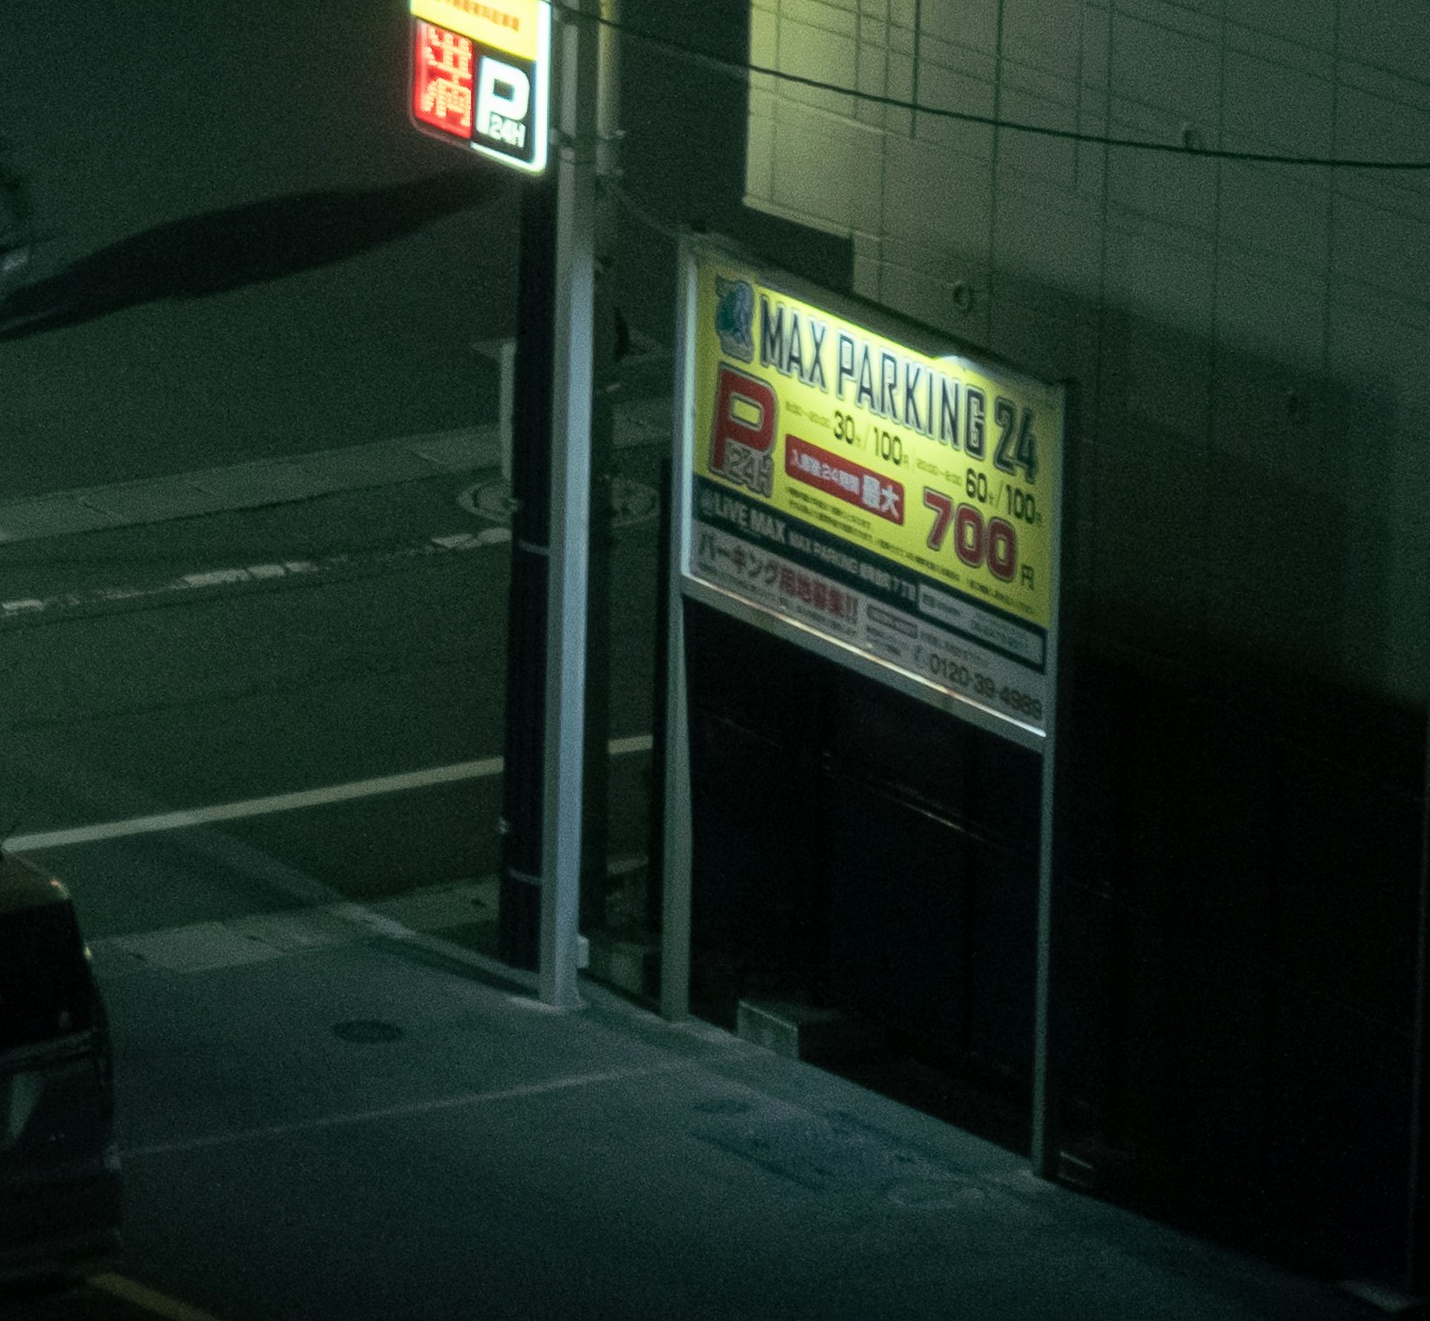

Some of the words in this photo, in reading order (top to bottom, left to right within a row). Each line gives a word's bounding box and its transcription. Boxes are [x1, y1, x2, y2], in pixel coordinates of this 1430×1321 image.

[759, 294, 828, 393] MAX
[835, 331, 986, 459] PARKING
[992, 399, 1039, 485] 24
